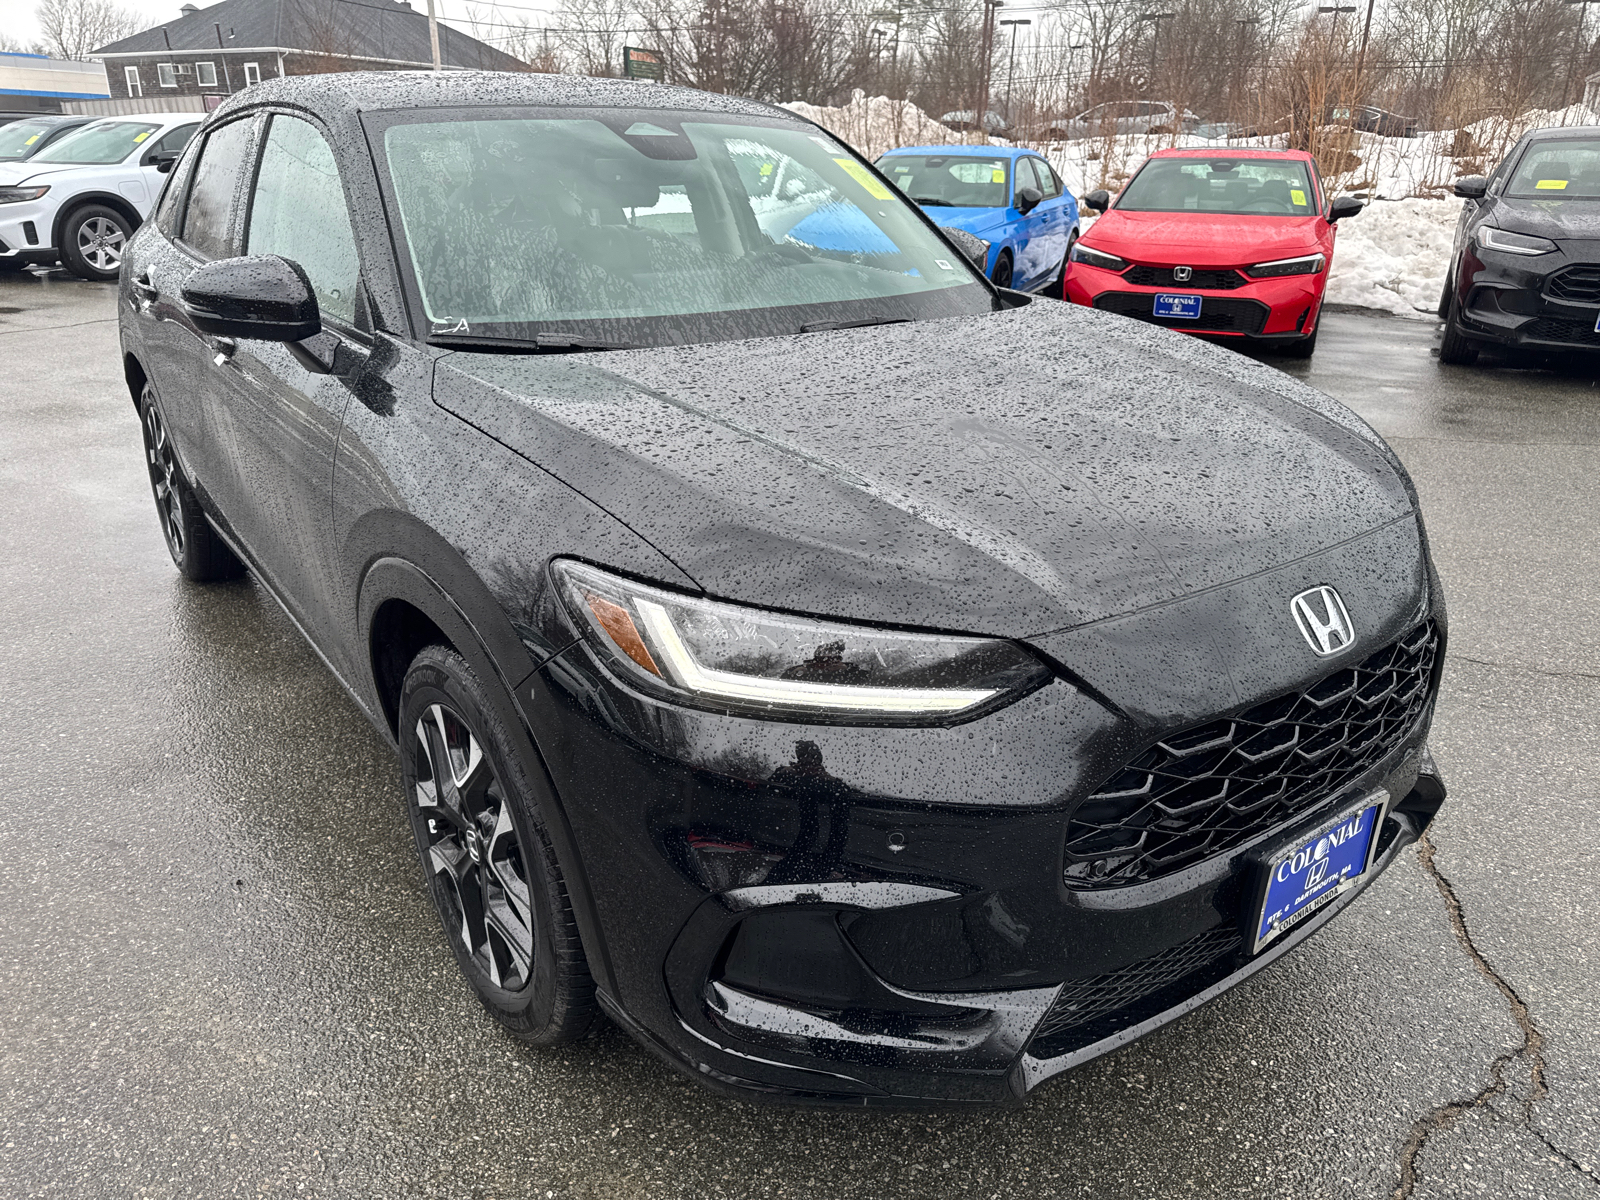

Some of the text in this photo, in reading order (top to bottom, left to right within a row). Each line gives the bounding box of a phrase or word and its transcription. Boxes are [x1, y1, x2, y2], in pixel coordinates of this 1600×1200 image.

[1160, 296, 1196, 305] COLONIAL
[1277, 818, 1364, 883] COLONIAL
[1267, 864, 1352, 925] RTE. 6 DARTMOUTH, MA
[1278, 887, 1339, 932] COLONIAL HONDA
